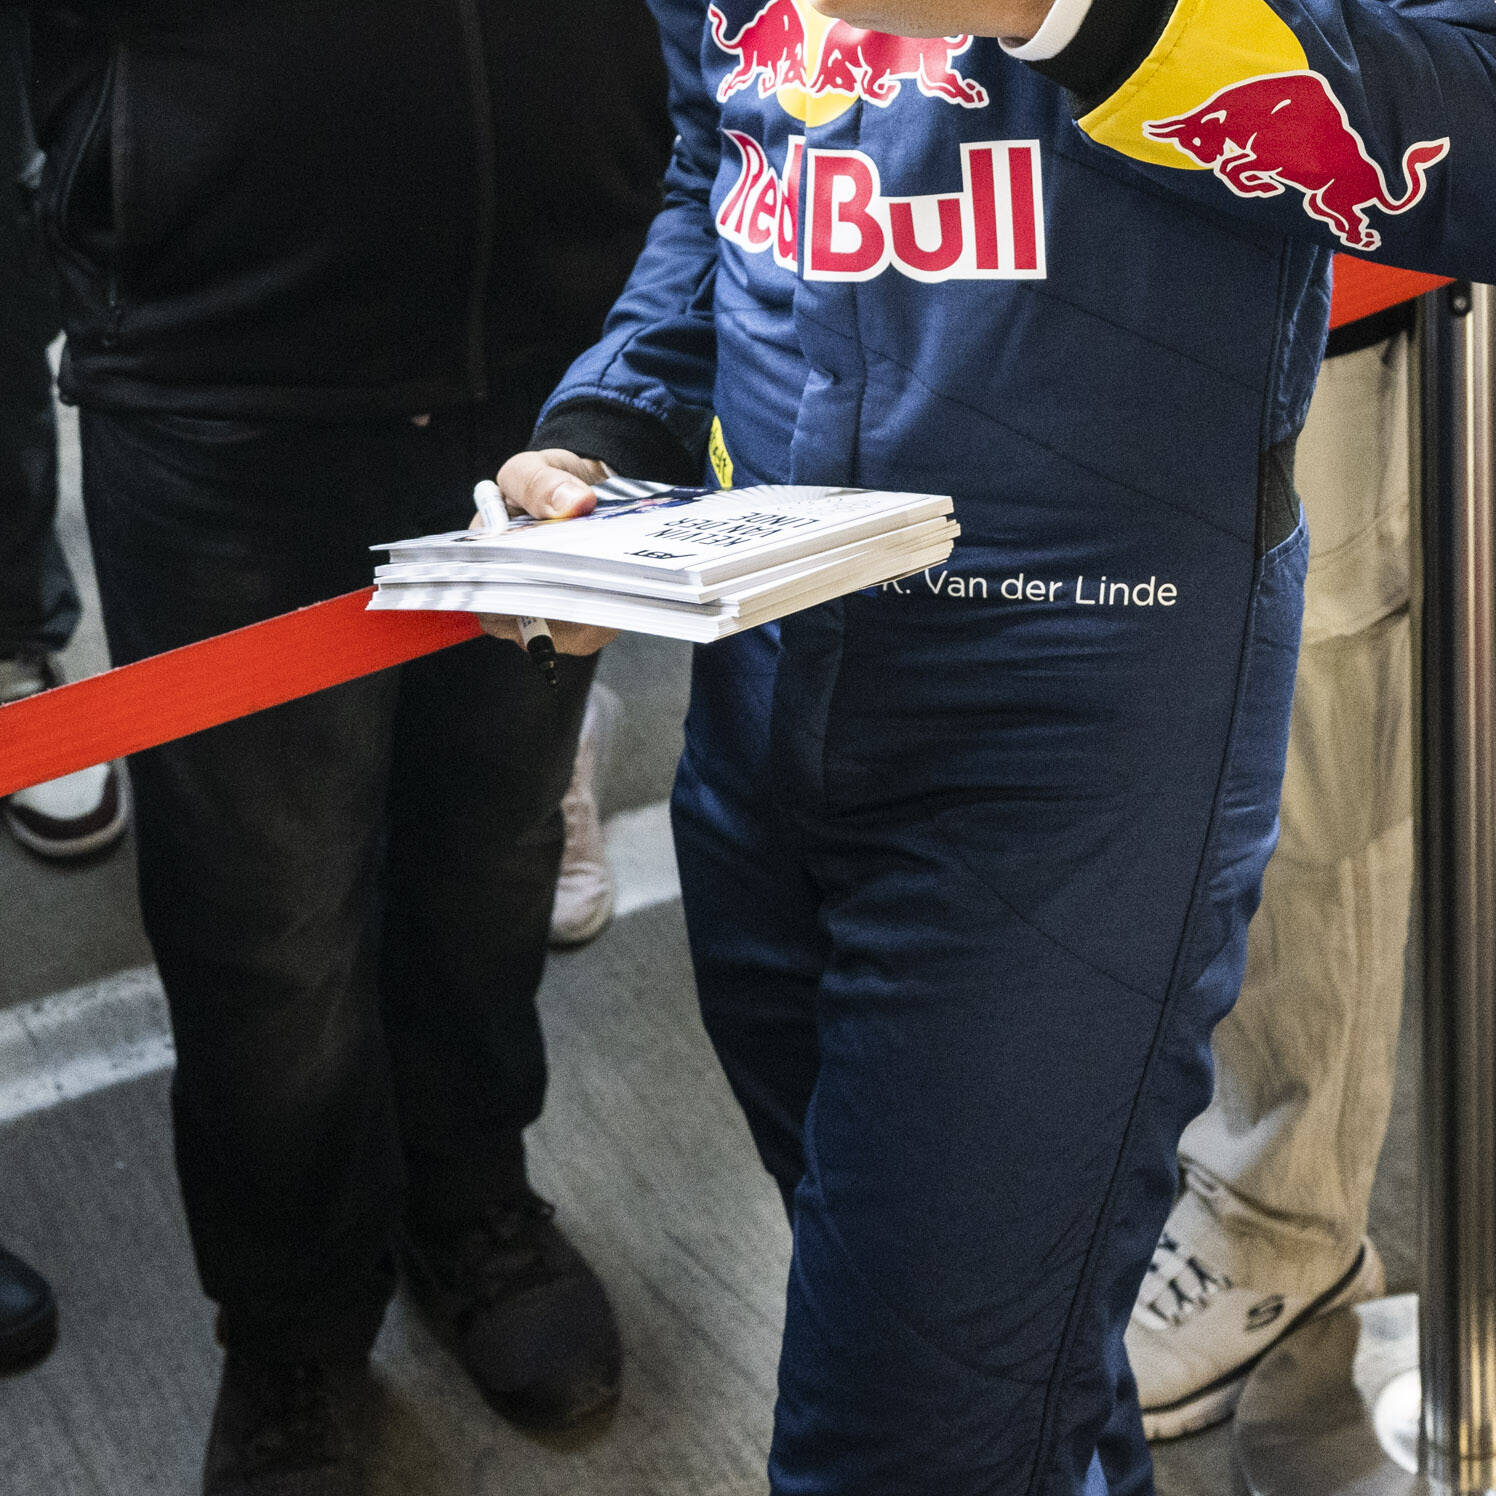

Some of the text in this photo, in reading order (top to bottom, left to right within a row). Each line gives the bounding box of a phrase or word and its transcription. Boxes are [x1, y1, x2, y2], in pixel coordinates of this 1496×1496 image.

[664, 517, 782, 538] VAN DER
[729, 512, 820, 529] LINDE
[646, 528, 752, 548] KELVIN
[924, 568, 988, 599] Van
[1000, 572, 1063, 603] der
[1075, 575, 1178, 606] Linde
